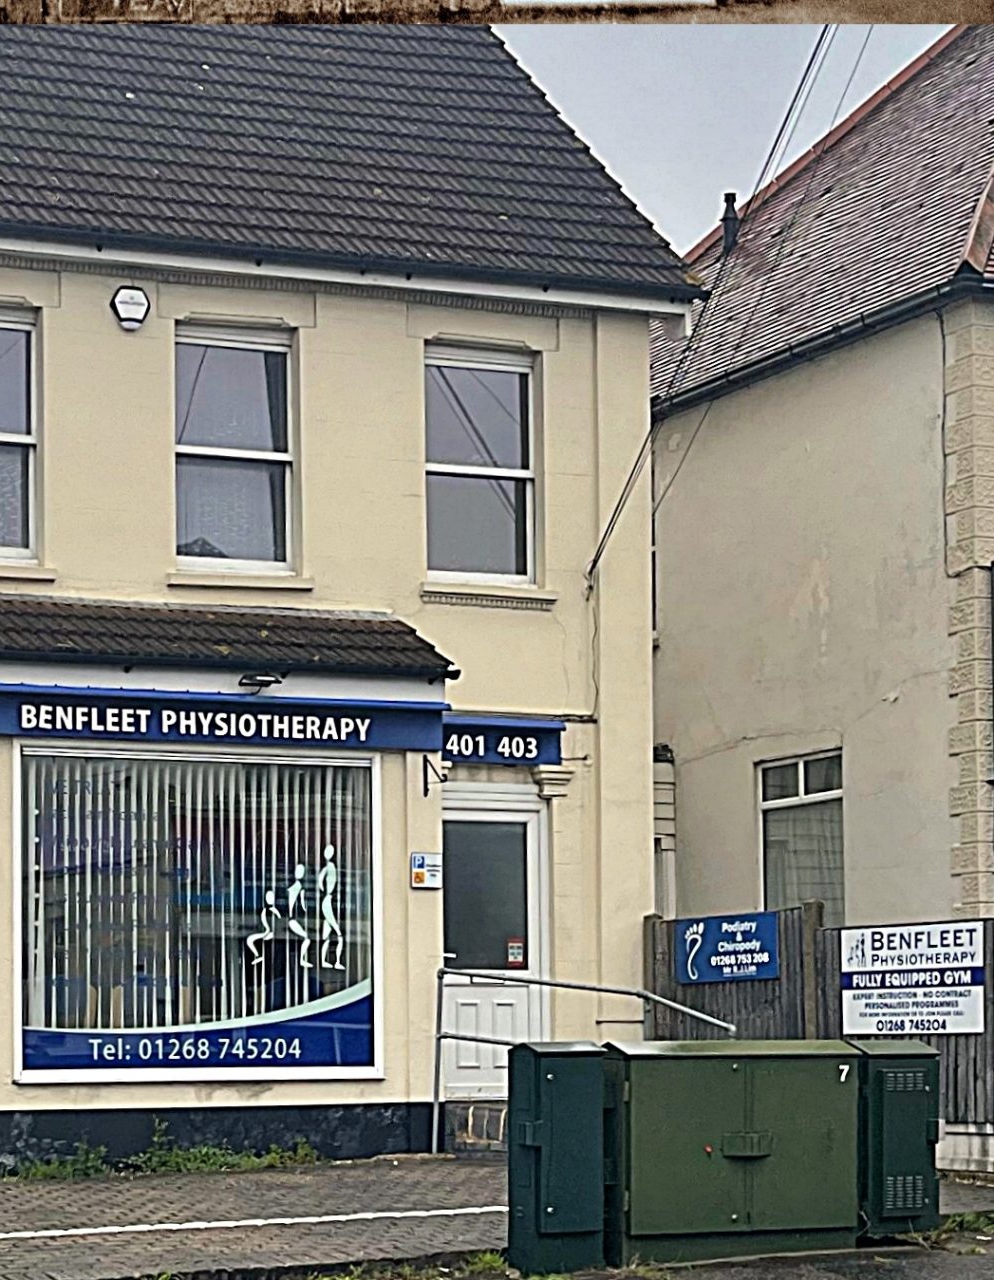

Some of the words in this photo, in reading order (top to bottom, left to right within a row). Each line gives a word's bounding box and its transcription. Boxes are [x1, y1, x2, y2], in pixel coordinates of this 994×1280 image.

[20, 704, 151, 734] BENFLEET
[161, 709, 372, 743] PHYSIOTHERAPY
[446, 734, 485, 757] 401
[497, 736, 539, 759] 403
[721, 921, 757, 933] Podiatry
[718, 939, 761, 953] Chiropody
[870, 928, 978, 952] BENFLEET
[710, 955, 736, 967] 01268
[737, 953, 752, 964] 753
[870, 951, 977, 967] PHYSIOTHERAPY
[852, 973, 883, 988] FULLY
[885, 971, 941, 987] EQUIPPED
[943, 969, 972, 985] GYM
[935, 989, 972, 998] CONTRACT
[876, 1019, 906, 1032] 01268
[908, 1018, 948, 1032] 745204
[88, 1038, 132, 1061] Tel:
[138, 1038, 211, 1060] 01268
[218, 1038, 303, 1060] 745204
[838, 1064, 851, 1083] 7
